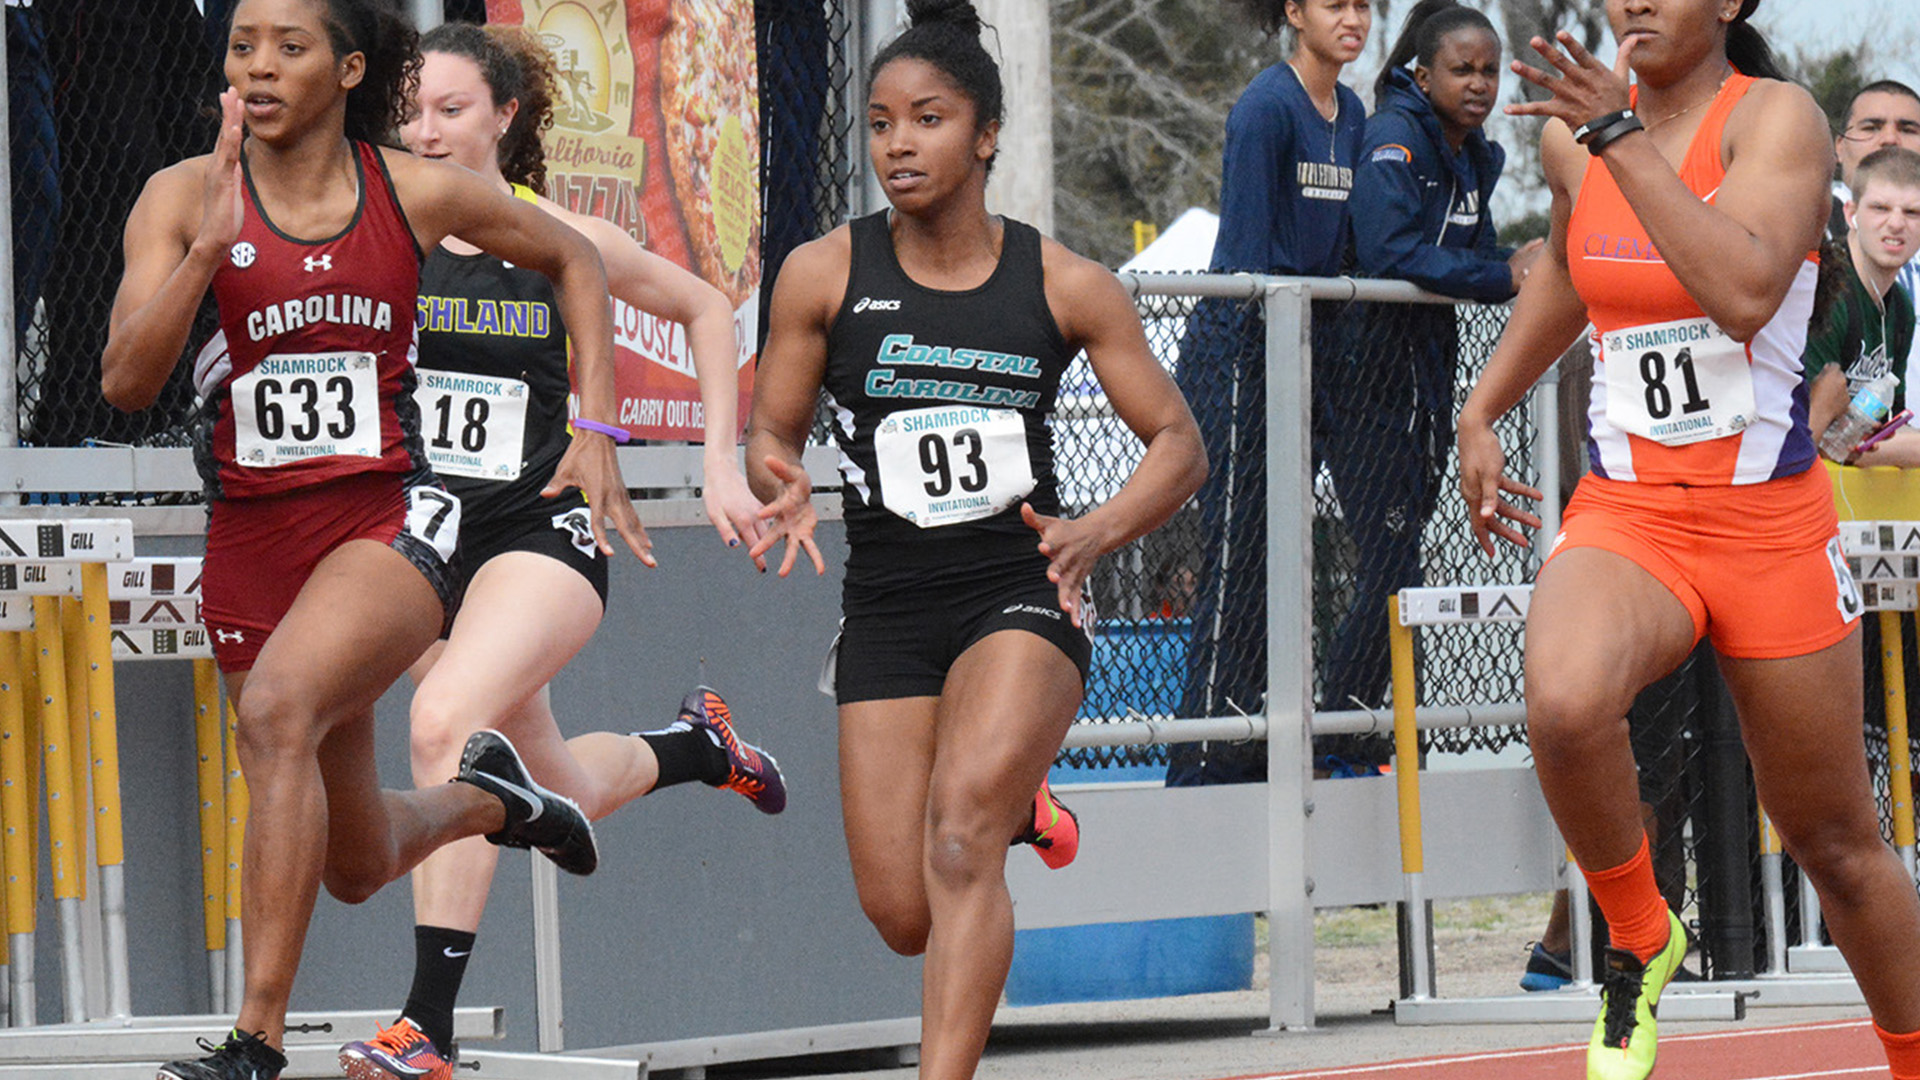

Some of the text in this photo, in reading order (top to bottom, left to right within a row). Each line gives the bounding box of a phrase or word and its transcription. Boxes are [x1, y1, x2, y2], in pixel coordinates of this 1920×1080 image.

[544, 136, 635, 168] alifornia
[545, 173, 646, 246] IZZA
[247, 294, 392, 342] CAROLINA
[417, 295, 550, 338] SHLAND
[1626, 323, 1711, 350] SHAMROCK
[260, 356, 347, 375] SHAMROCK
[427, 375, 502, 396] SHAMROCK
[865, 369, 1041, 409] CAROLINA
[1639, 347, 1710, 420] 81
[254, 376, 356, 441] 633
[620, 397, 665, 426] CARRY
[903, 408, 991, 432] SHAMROCK
[431, 395, 490, 453] 18
[1650, 416, 1714, 436] INVITATIONAL
[276, 445, 338, 456] INVITATIONAL
[429, 452, 482, 467] INVITATIONAL
[918, 428, 988, 497] 93
[419, 491, 454, 541] 7
[928, 497, 991, 513] INVITATIONAL
[70, 533, 94, 549] GILL
[24, 566, 47, 582] GILL
[123, 571, 145, 587] GILL
[184, 630, 205, 646] GILL
